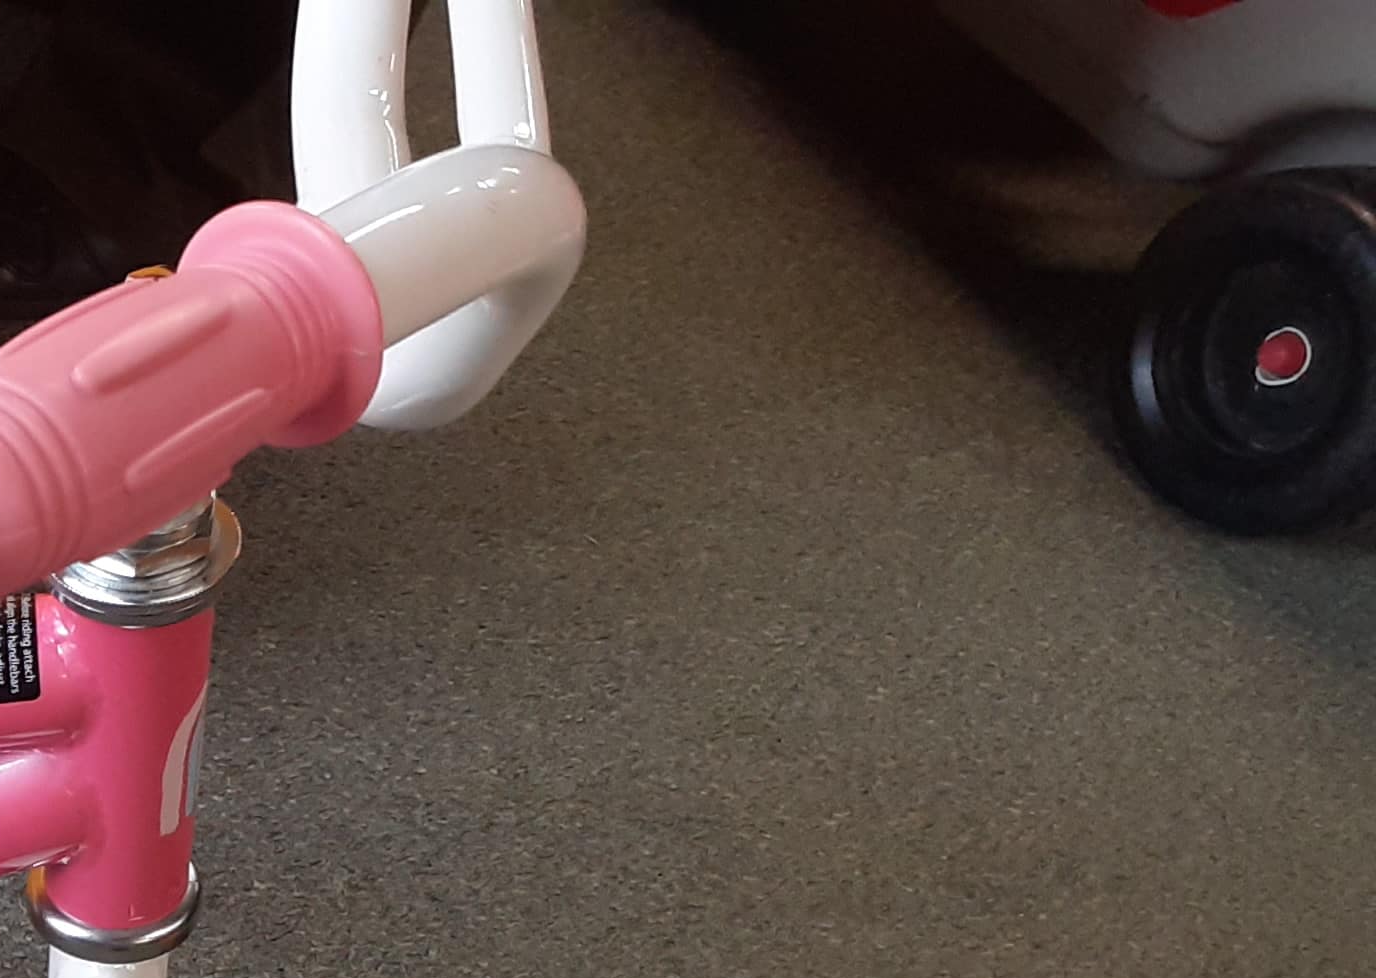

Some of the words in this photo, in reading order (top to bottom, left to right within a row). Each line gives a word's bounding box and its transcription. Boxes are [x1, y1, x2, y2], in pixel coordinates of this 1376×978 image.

[21, 619, 33, 647] riding
[9, 635, 21, 694] handlebars
[24, 649, 36, 683] attach
